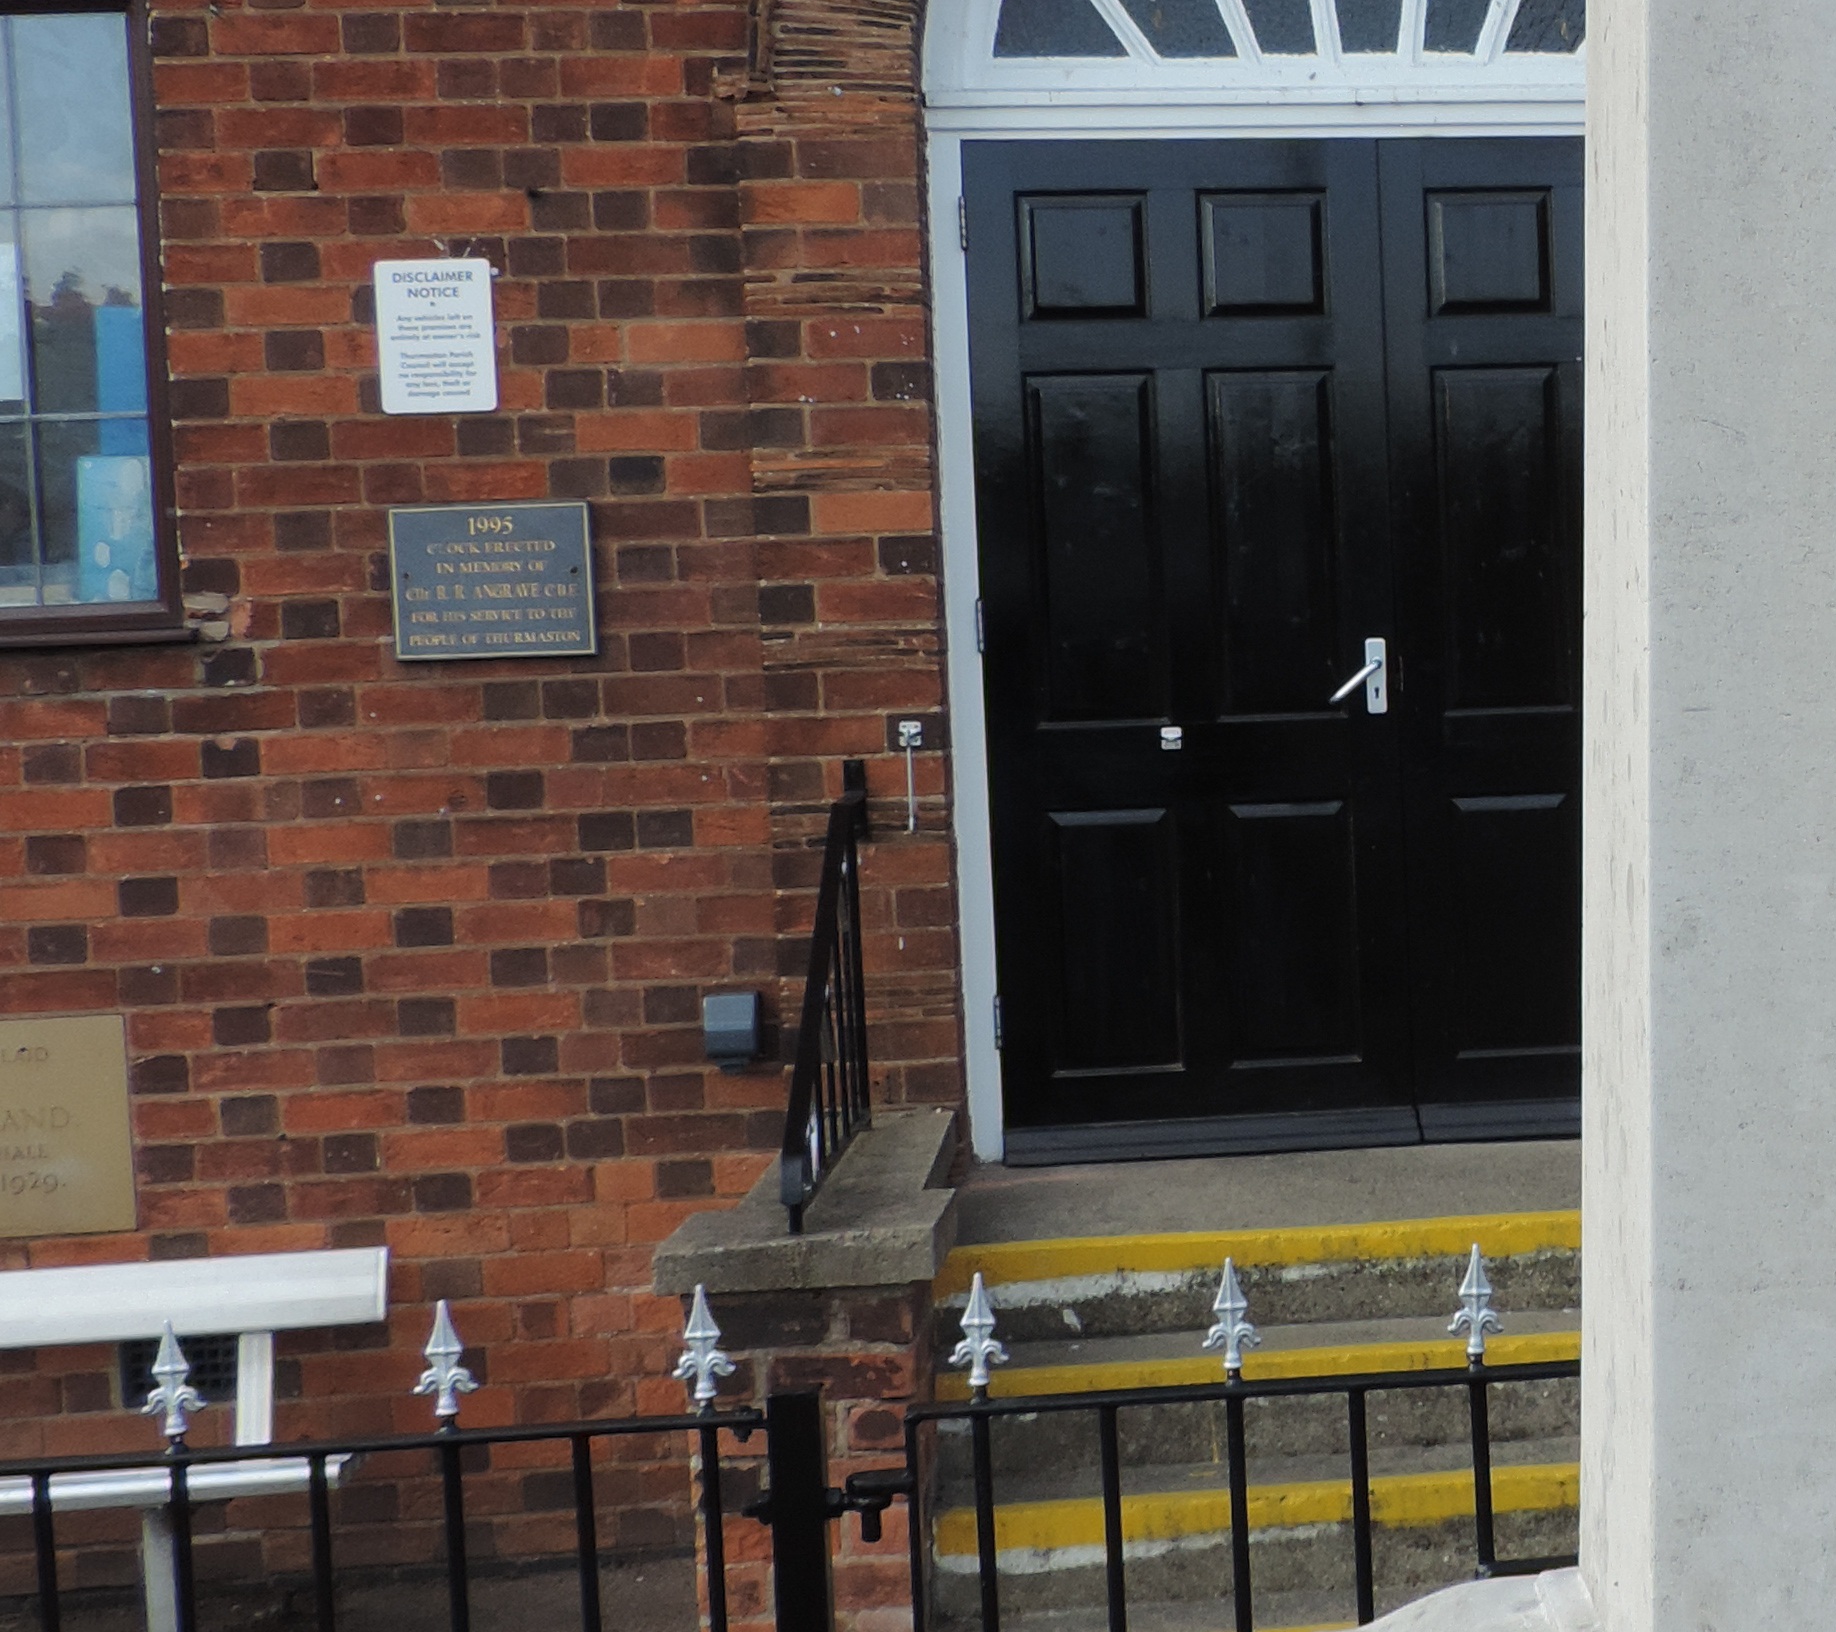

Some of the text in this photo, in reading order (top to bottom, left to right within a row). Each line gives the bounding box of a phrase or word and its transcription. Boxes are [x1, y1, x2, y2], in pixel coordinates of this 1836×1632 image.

[392, 271, 474, 284] DISCLAIMER
[406, 286, 460, 299] NOTICE
[466, 515, 514, 536] 1995
[484, 539, 557, 554] ERECTED
[459, 560, 523, 574] MEMORY
